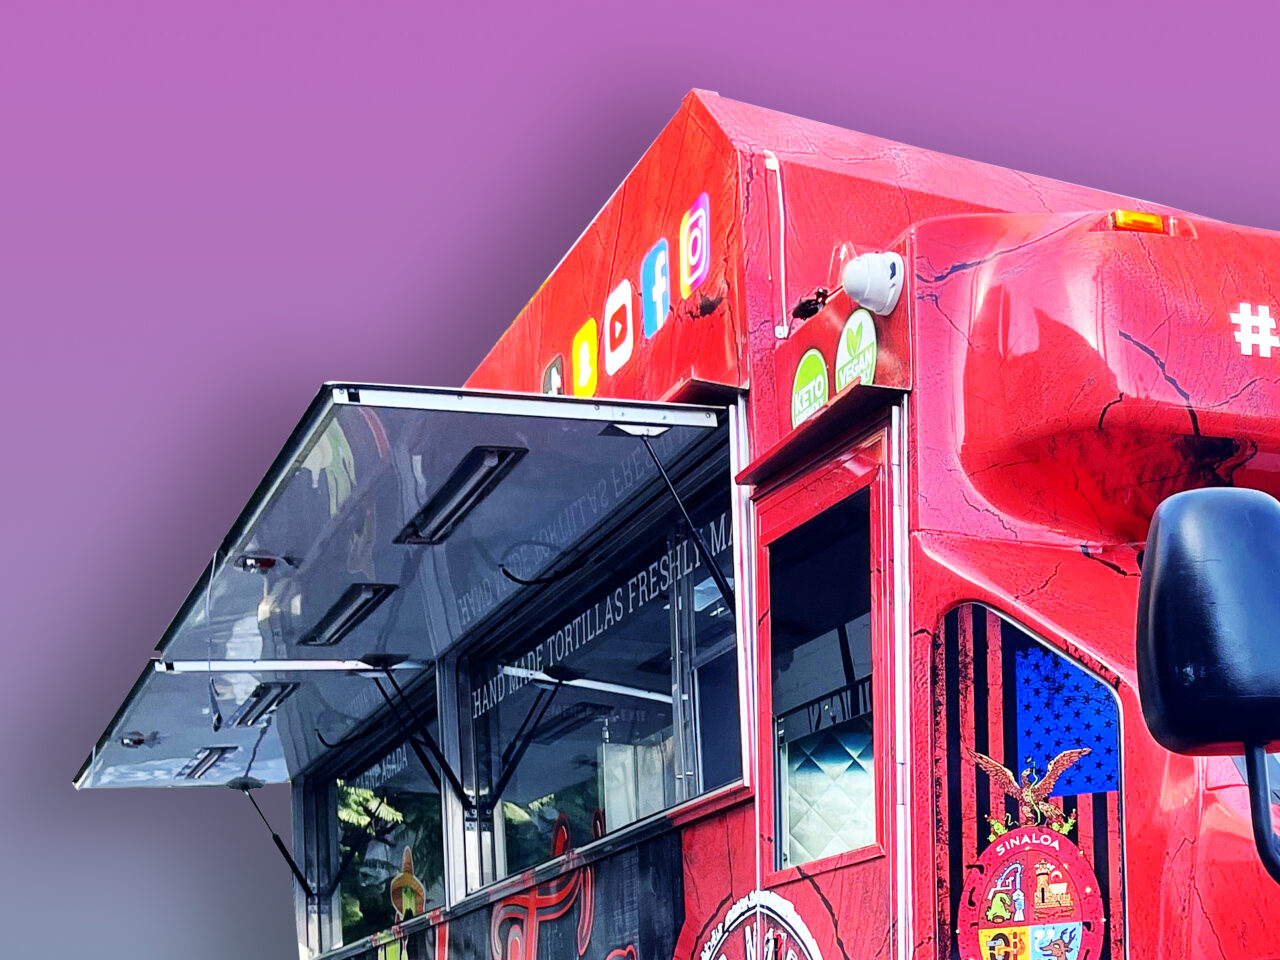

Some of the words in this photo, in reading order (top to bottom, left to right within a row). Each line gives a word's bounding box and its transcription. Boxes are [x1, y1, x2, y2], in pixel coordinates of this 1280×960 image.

[839, 346, 873, 387] VEGAN
[795, 373, 824, 416] KETO
[472, 671, 505, 719] HAND
[509, 642, 544, 695] MADE
[546, 587, 624, 666] TORTILLAS
[627, 528, 703, 613] FRESHLY
[709, 512, 733, 557] M
[996, 832, 1060, 857] SINALOA
